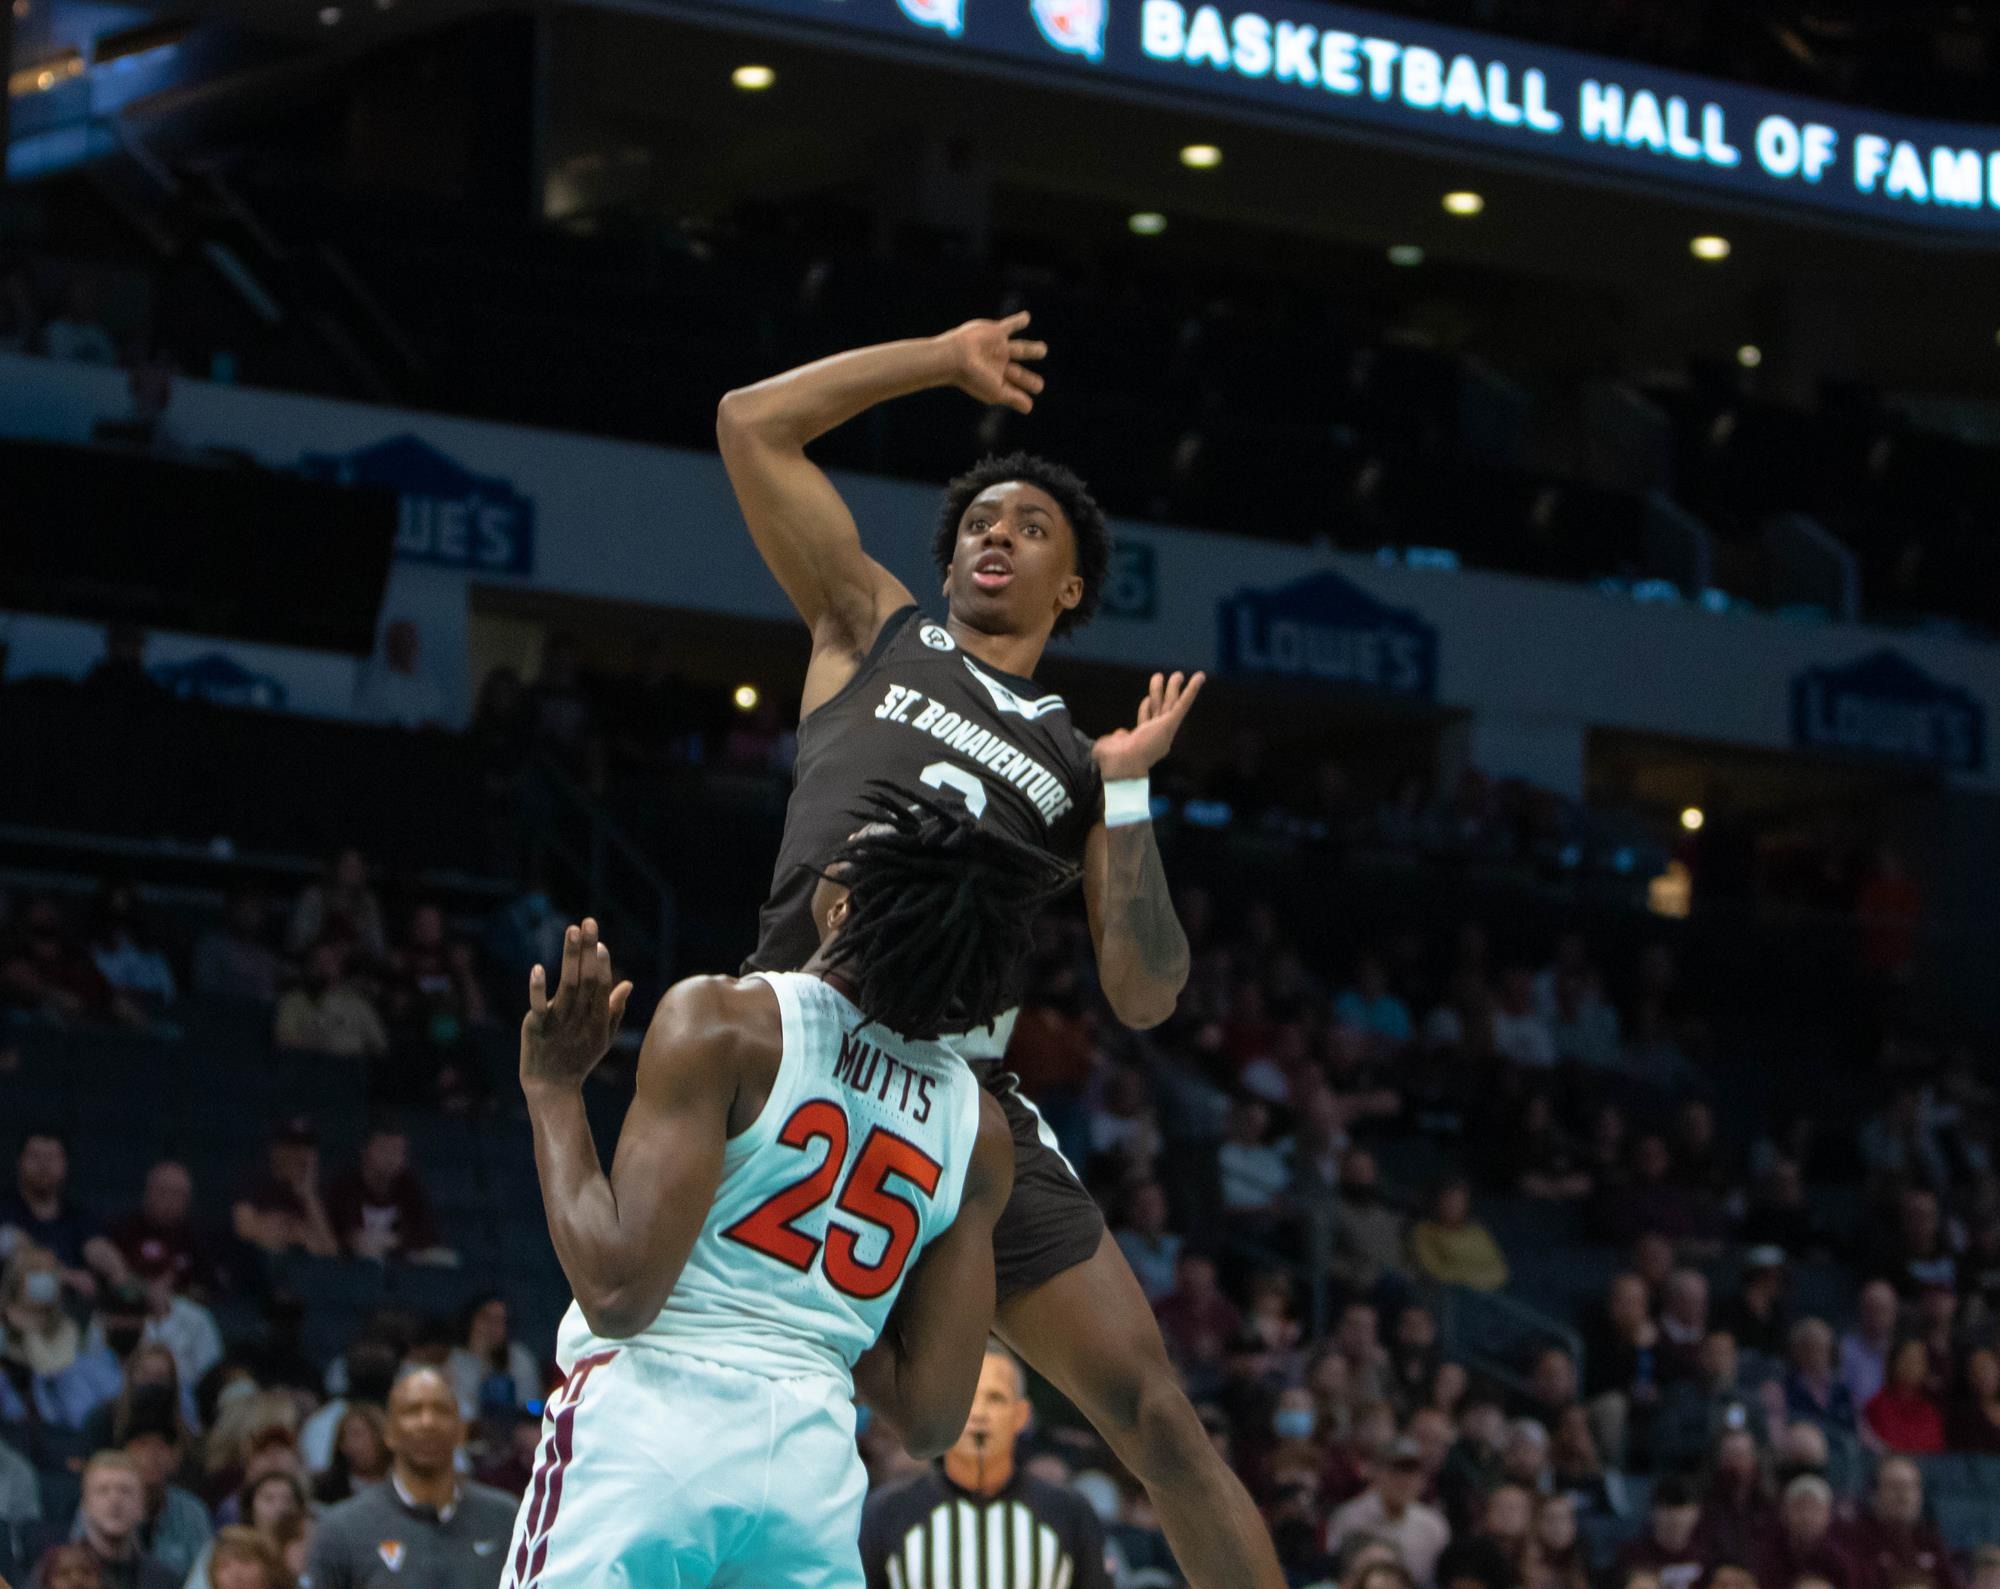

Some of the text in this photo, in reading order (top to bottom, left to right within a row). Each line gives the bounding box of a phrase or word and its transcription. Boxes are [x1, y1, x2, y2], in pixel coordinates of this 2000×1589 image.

[1140, 0, 1561, 132] BASKETBALL
[1579, 80, 1739, 166] HALL
[1755, 114, 1838, 183] OF
[875, 684, 922, 723] ST.
[911, 698, 1074, 828] BONAVENTURE
[832, 1031, 937, 1124] MUTTS
[717, 1098, 944, 1300] 25
